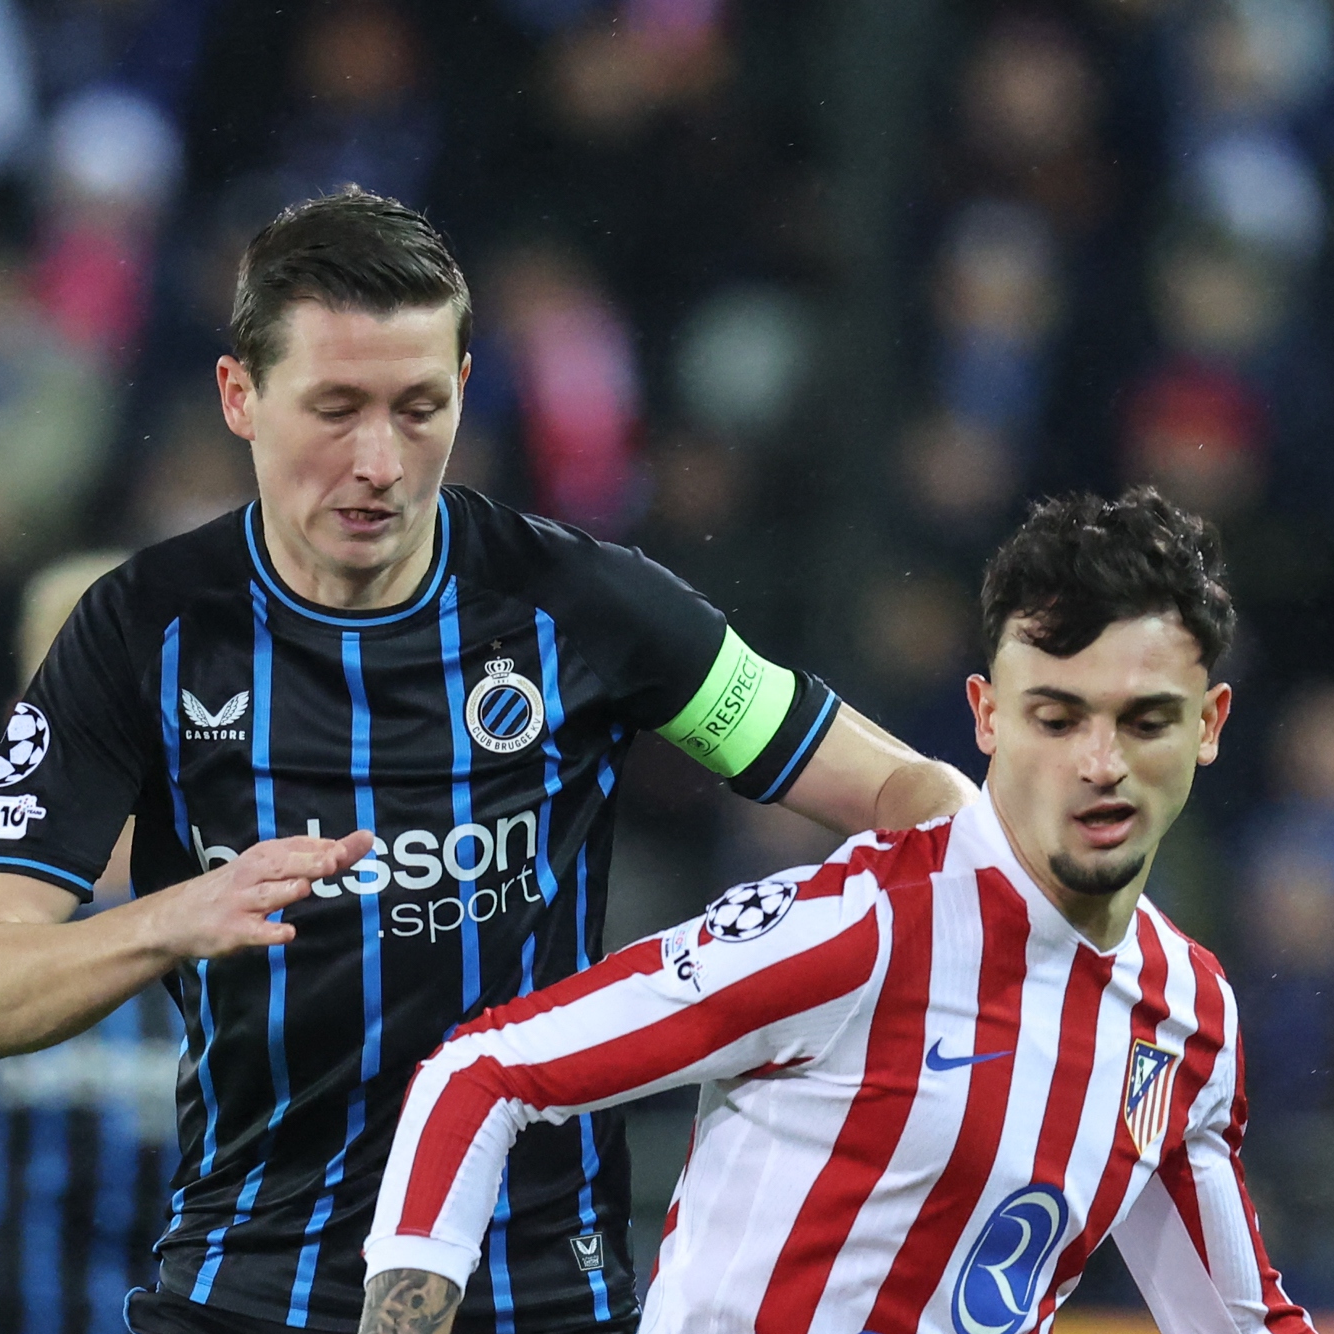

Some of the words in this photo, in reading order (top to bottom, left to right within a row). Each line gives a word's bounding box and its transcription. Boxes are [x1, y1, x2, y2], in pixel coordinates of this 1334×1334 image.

[705, 654, 758, 737] RESPECT
[185, 729, 246, 741] CASTORE
[472, 726, 492, 747] CLUB
[494, 732, 533, 751] BRUGGE
[530, 717, 541, 732] KV
[0, 805, 26, 827] 10
[378, 864, 541, 944] .sport
